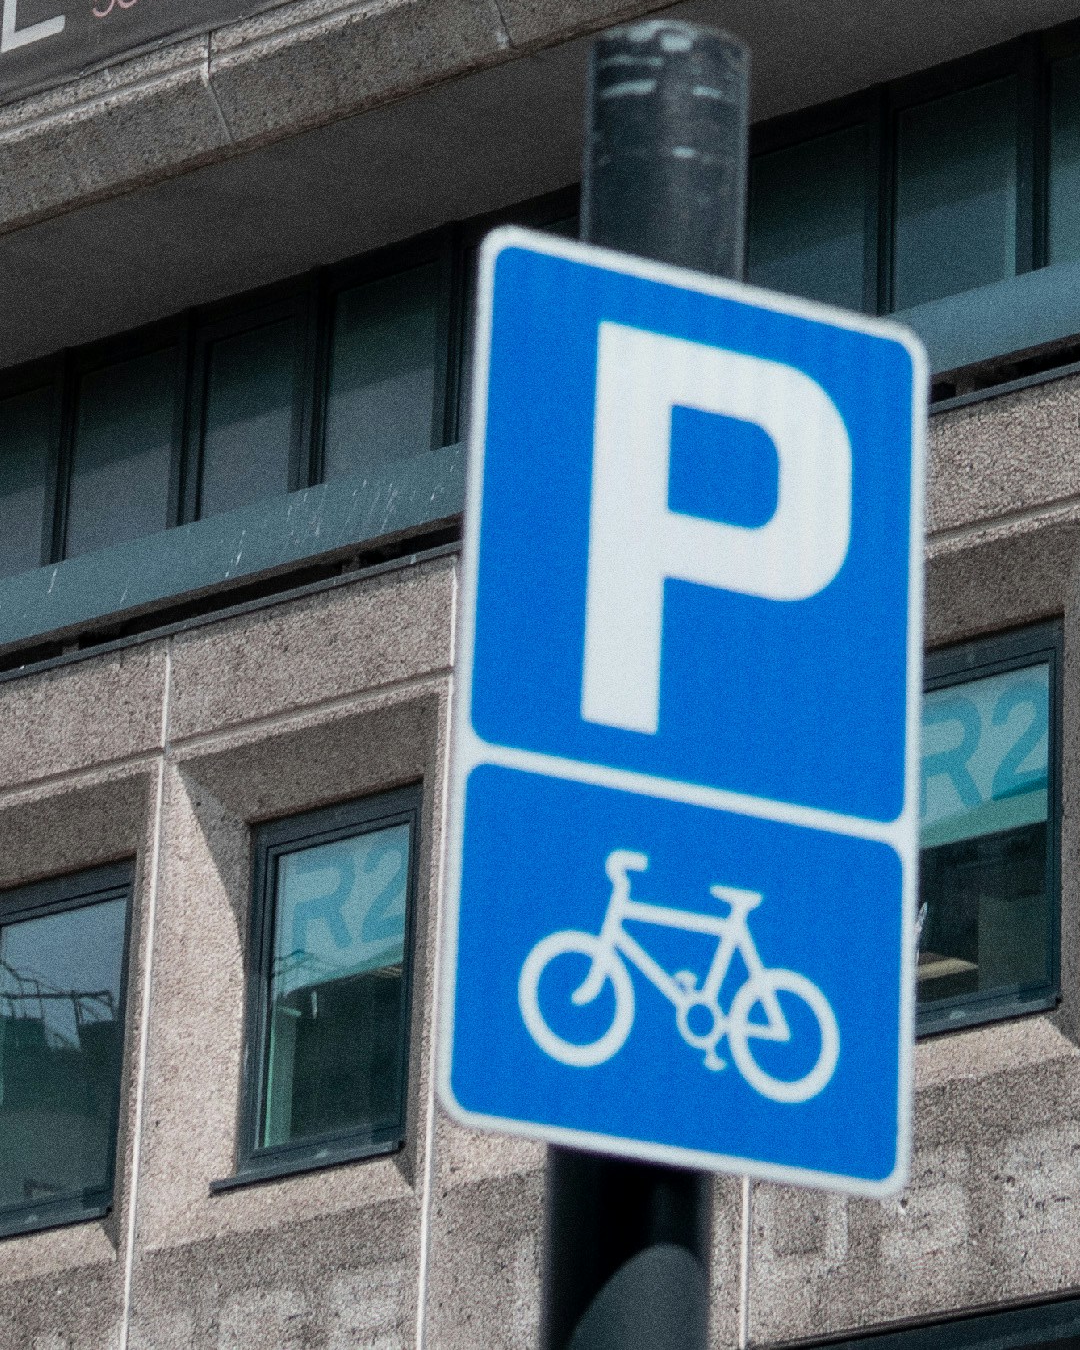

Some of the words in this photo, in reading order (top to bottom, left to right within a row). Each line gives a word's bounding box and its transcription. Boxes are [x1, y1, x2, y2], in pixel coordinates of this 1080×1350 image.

[581, 320, 852, 735] P
[920, 679, 1049, 820] R2
[292, 827, 408, 958] R2
